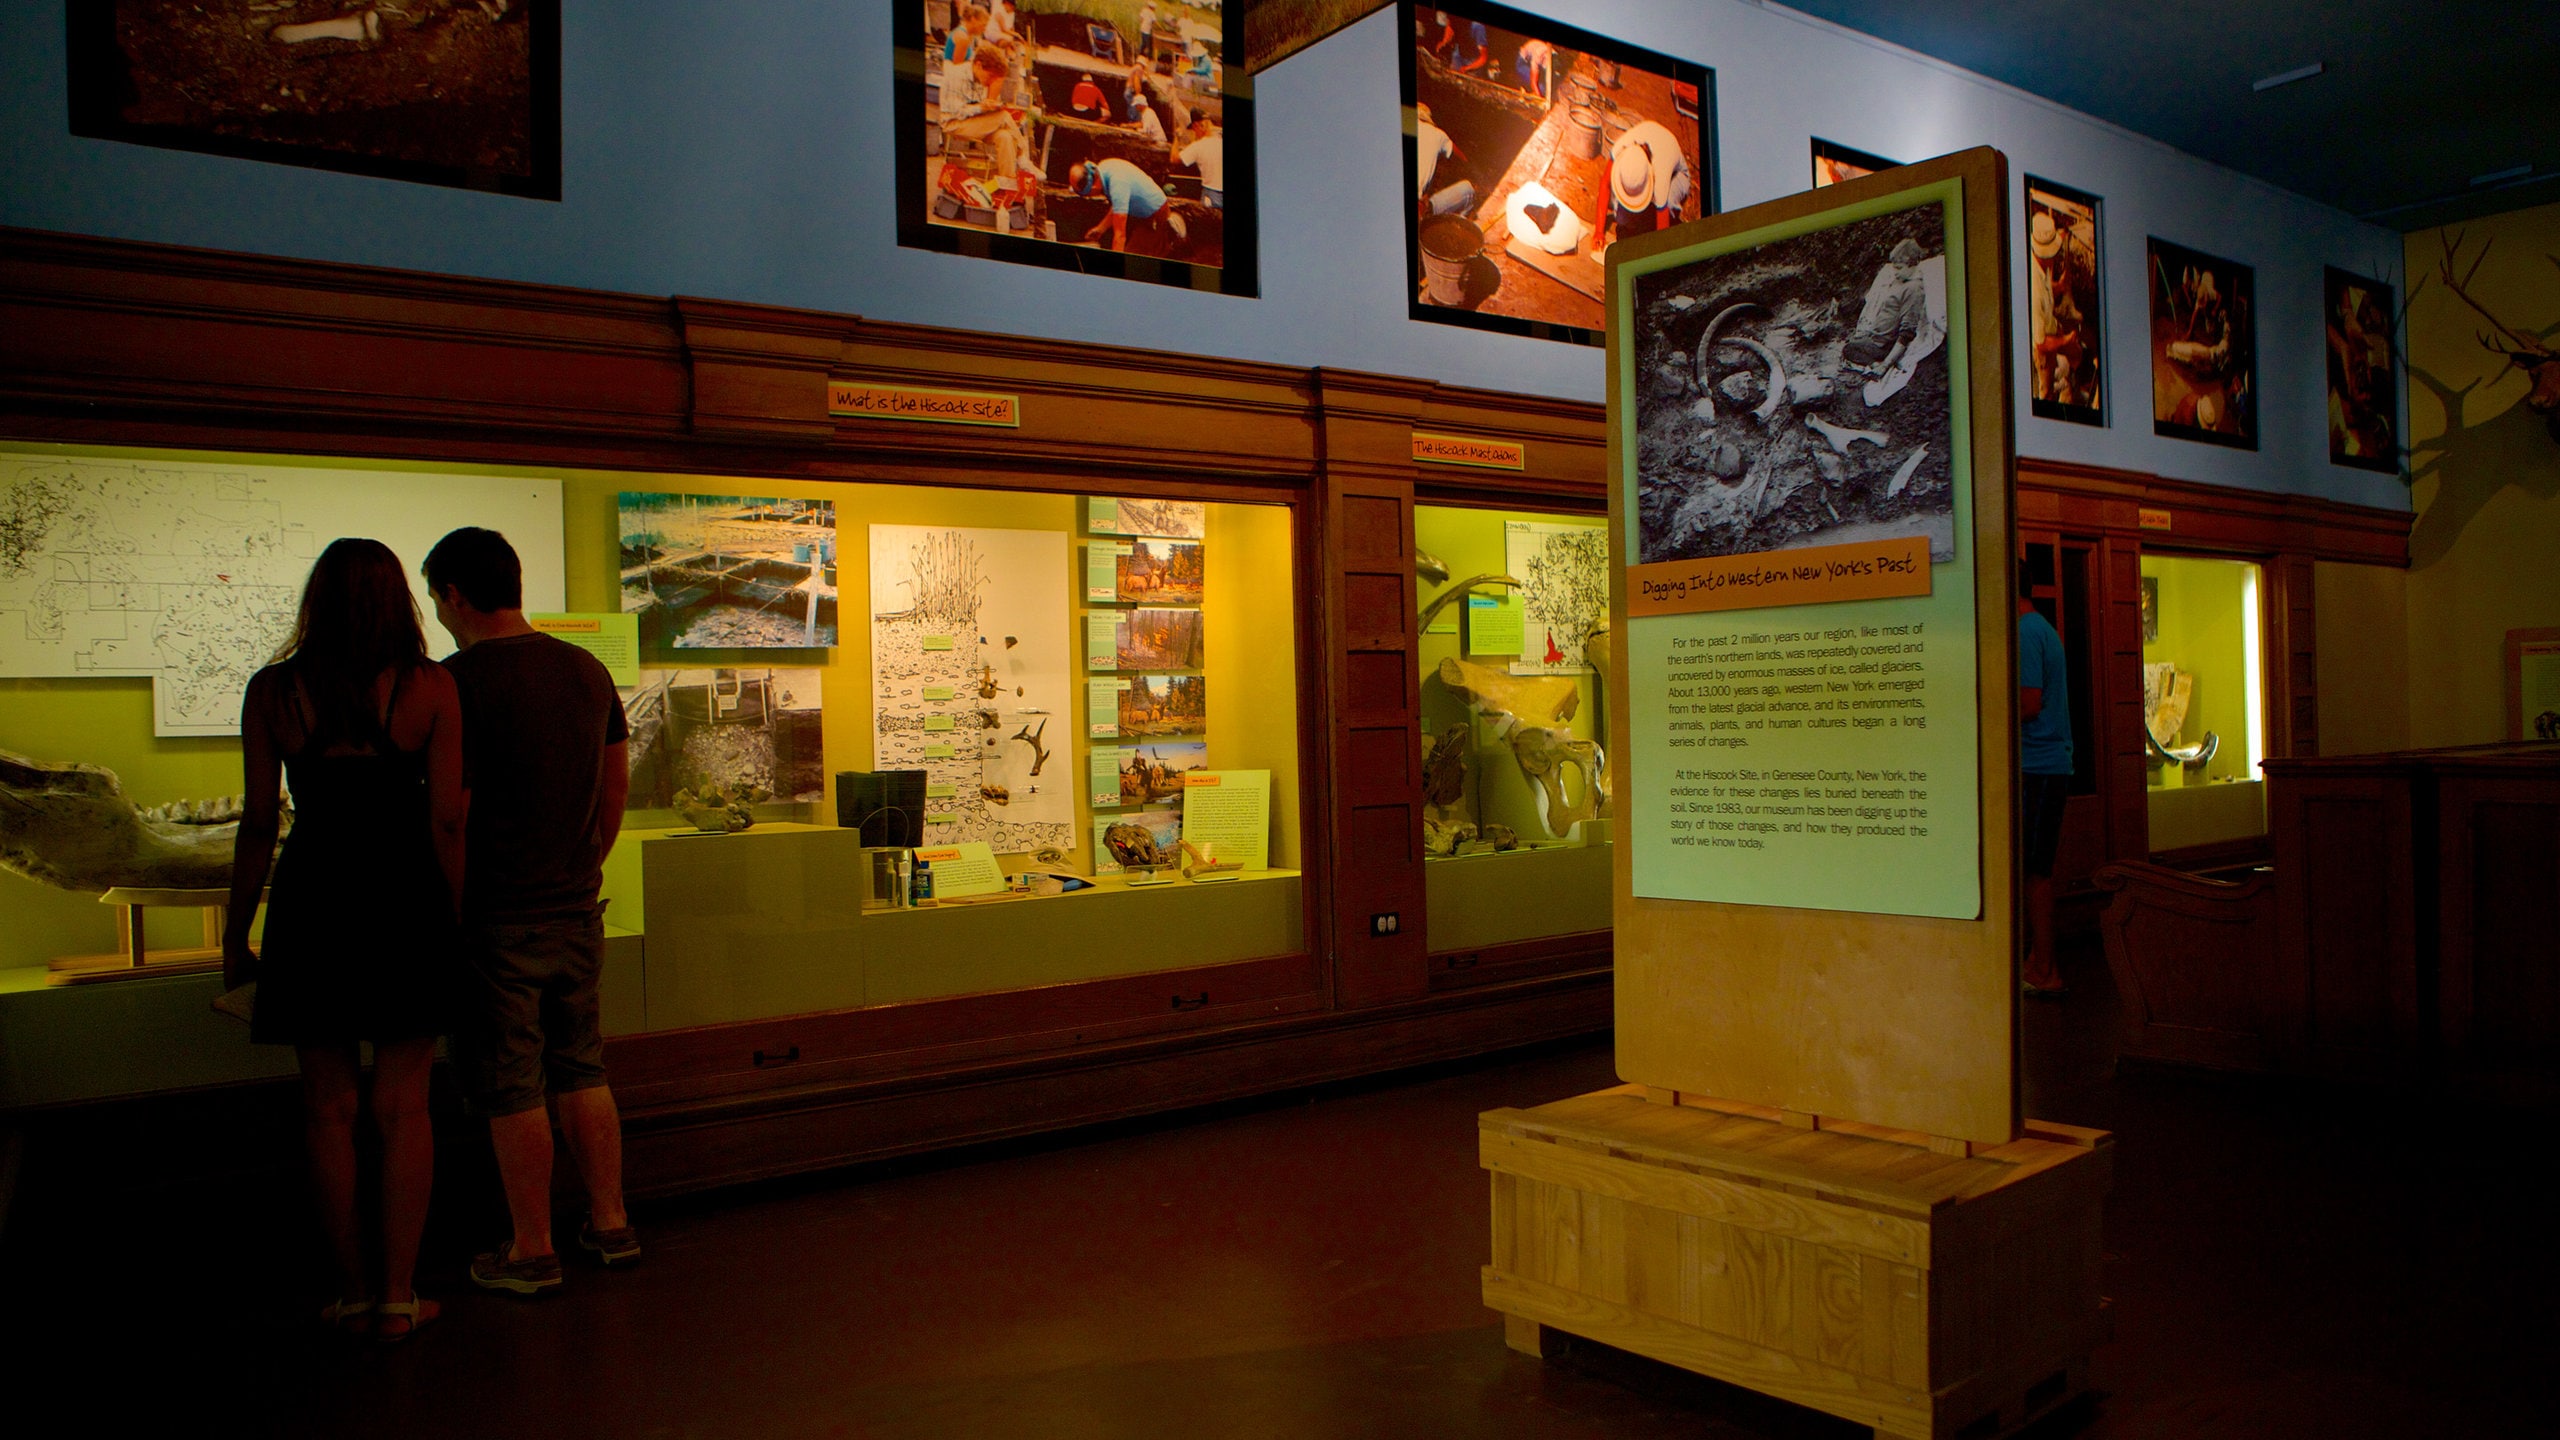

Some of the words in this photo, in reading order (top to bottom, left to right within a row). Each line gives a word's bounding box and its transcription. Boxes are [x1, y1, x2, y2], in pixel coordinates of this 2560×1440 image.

[837, 391, 874, 409] What
[877, 395, 888, 408] is
[892, 393, 916, 411] the
[920, 398, 969, 415] Hiscock
[973, 400, 1008, 418] Site?
[1414, 441, 1433, 453] The
[1435, 443, 1468, 456] Hiscock
[1471, 446, 1517, 461] Mastodons
[1642, 579, 1685, 600] Digging
[1689, 571, 1724, 591] Into
[1793, 566, 1822, 580] New
[1825, 560, 1872, 581] York's
[1876, 552, 1917, 574] Past
[1673, 638, 1687, 648] For
[1690, 637, 1705, 648] the
[1708, 636, 1727, 648] past
[1731, 634, 1738, 645] 2
[1741, 634, 1770, 644] million
[1774, 633, 1800, 644] years
[1804, 632, 1820, 641] our
[1824, 629, 1856, 641] region,
[1861, 626, 1878, 637] like
[1882, 625, 1909, 636] most
[1913, 623, 1924, 634] of
[1668, 655, 1682, 665] the
[1684, 653, 1713, 664] earth's
[1715, 652, 1754, 663] northern
[1756, 650, 1784, 660] lands,
[1786, 649, 1805, 659] was
[1807, 645, 1858, 659] repeatedly
[1861, 643, 1901, 655] covered
[1903, 642, 1923, 653] and
[1668, 671, 1713, 681] uncovered
[1715, 669, 1726, 681] by
[1728, 669, 1775, 679] enormous
[1777, 666, 1815, 676] masses
[1817, 664, 1827, 675] of
[1830, 664, 1846, 675] ice,
[1849, 662, 1879, 674] called
[1882, 661, 1924, 675] glaciers.
[1668, 687, 1694, 698] About
[1697, 686, 1731, 698] 13,000
[1734, 686, 1758, 698] years
[1762, 686, 1781, 697] ago,
[1785, 683, 1823, 693] western
[1827, 681, 1849, 692] New
[1853, 681, 1874, 691] York
[1878, 679, 1924, 692] emerged
[1669, 704, 1688, 714] from
[1692, 704, 1706, 713] the
[1709, 703, 1734, 713] latest
[1737, 702, 1765, 715] glacial
[1768, 701, 1811, 712] advance,
[1814, 700, 1833, 710] and
[1837, 699, 1849, 710] its
[1852, 698, 1926, 709] environments,
[1669, 721, 1705, 731] animals,
[1710, 720, 1740, 731] plants,
[1745, 719, 1763, 729] and
[1768, 719, 1802, 728] human
[1807, 718, 1847, 728] cultures
[1852, 717, 1884, 729] began
[1890, 718, 1897, 726] a
[1903, 716, 1926, 728] long
[1669, 737, 1695, 747] series
[1697, 736, 1706, 747] of
[1708, 737, 1748, 748] changes.
[1676, 770, 1684, 780] At
[1686, 770, 1700, 780] the
[1703, 770, 1738, 780] Hiscock
[1740, 769, 1759, 780] Site,
[1762, 770, 1770, 780] in
[1772, 770, 1815, 780] Genesee
[1818, 770, 1854, 783] County,
[1857, 770, 1879, 780] New
[1882, 770, 1906, 781] York,
[1909, 770, 1926, 781] the
[1670, 786, 1709, 796] evidence
[1713, 786, 1725, 796] for
[1730, 787, 1755, 797] these
[1760, 787, 1799, 800] changes
[1804, 787, 1820, 798] lies
[1825, 788, 1856, 798] buried
[1862, 788, 1904, 799] beneath
[1909, 788, 1927, 799] the
[1670, 803, 1687, 812] soil.
[1689, 802, 1713, 813] Since
[1716, 803, 1743, 814] 1983,
[1745, 806, 1760, 814] our
[1763, 806, 1804, 815] museum
[1807, 805, 1825, 815] has
[1827, 805, 1852, 816] been
[1855, 806, 1892, 820] digging
[1894, 808, 1907, 819] up
[1910, 806, 1927, 818] the
[1670, 820, 1692, 831] story
[1696, 819, 1705, 829] of
[1708, 820, 1734, 830] those
[1738, 821, 1779, 834] changes,
[1783, 822, 1801, 832] and
[1807, 822, 1827, 833] how
[1831, 823, 1852, 836] they
[1857, 823, 1905, 836] produced
[1910, 826, 1928, 836] the
[1671, 836, 1694, 845] world
[1697, 838, 1709, 846] we
[1712, 836, 1736, 847] know
[1738, 838, 1765, 850] today.
